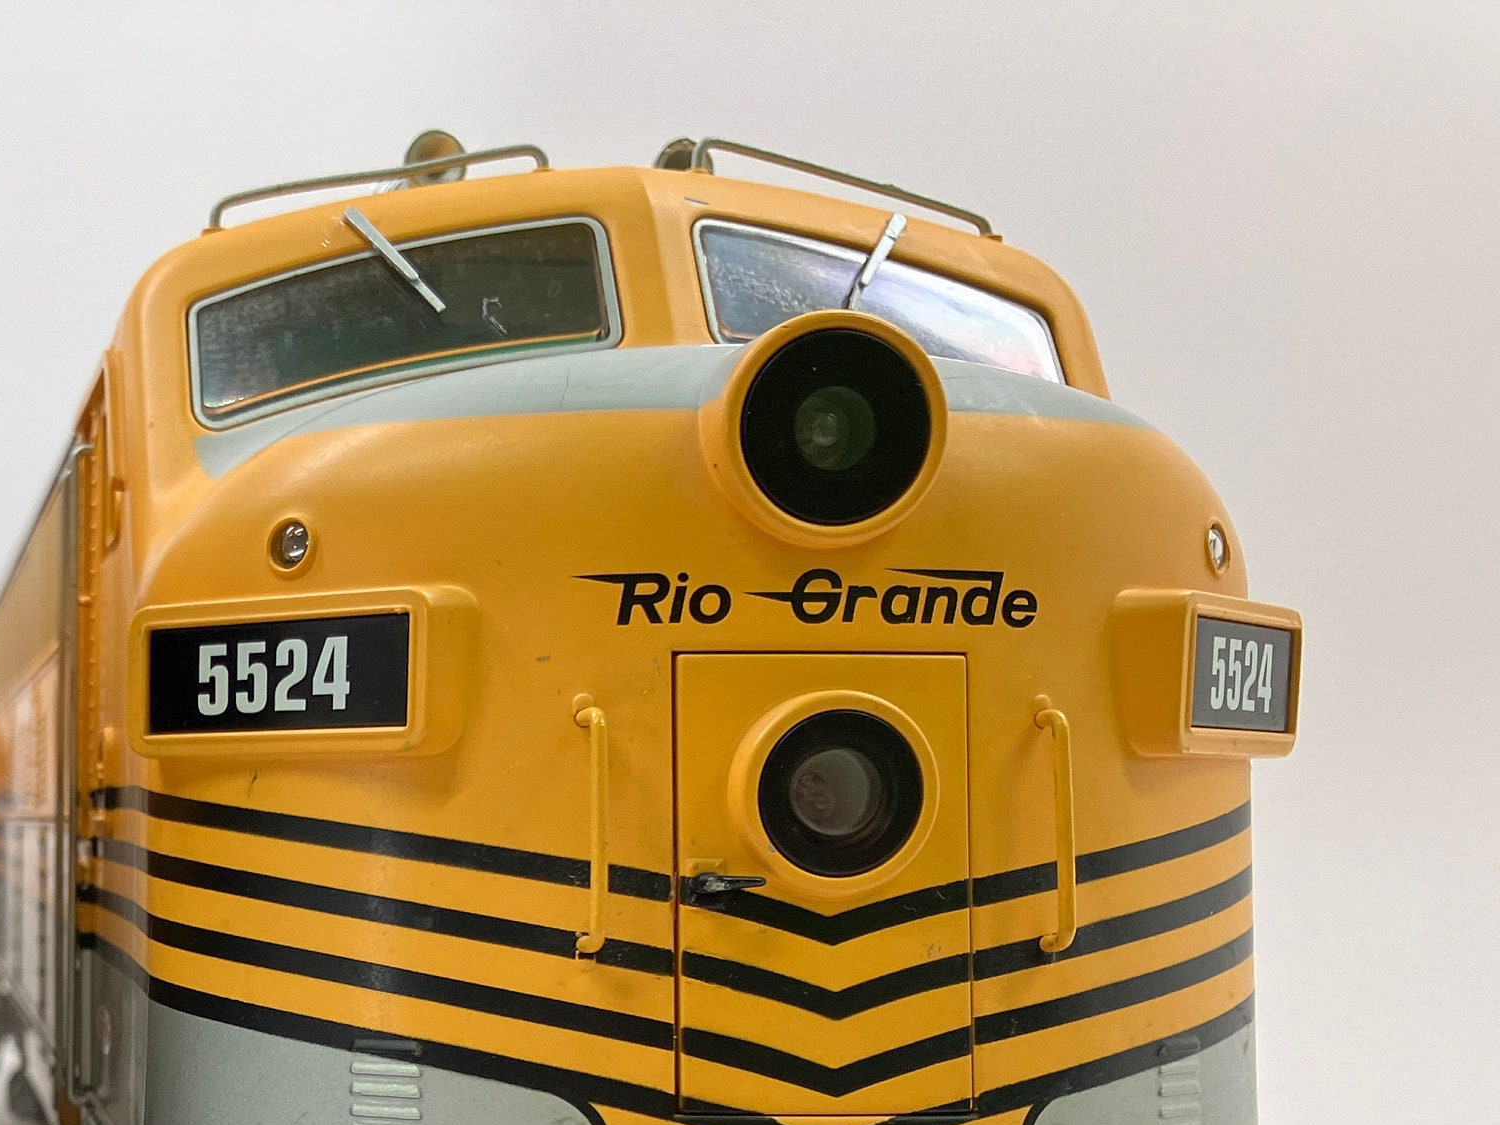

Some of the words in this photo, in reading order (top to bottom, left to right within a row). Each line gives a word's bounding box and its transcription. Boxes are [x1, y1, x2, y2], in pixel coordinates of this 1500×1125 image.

[570, 571, 732, 627] Rio
[743, 567, 1038, 629] Grande
[197, 635, 350, 716] 5524
[1210, 636, 1274, 714] 5524
